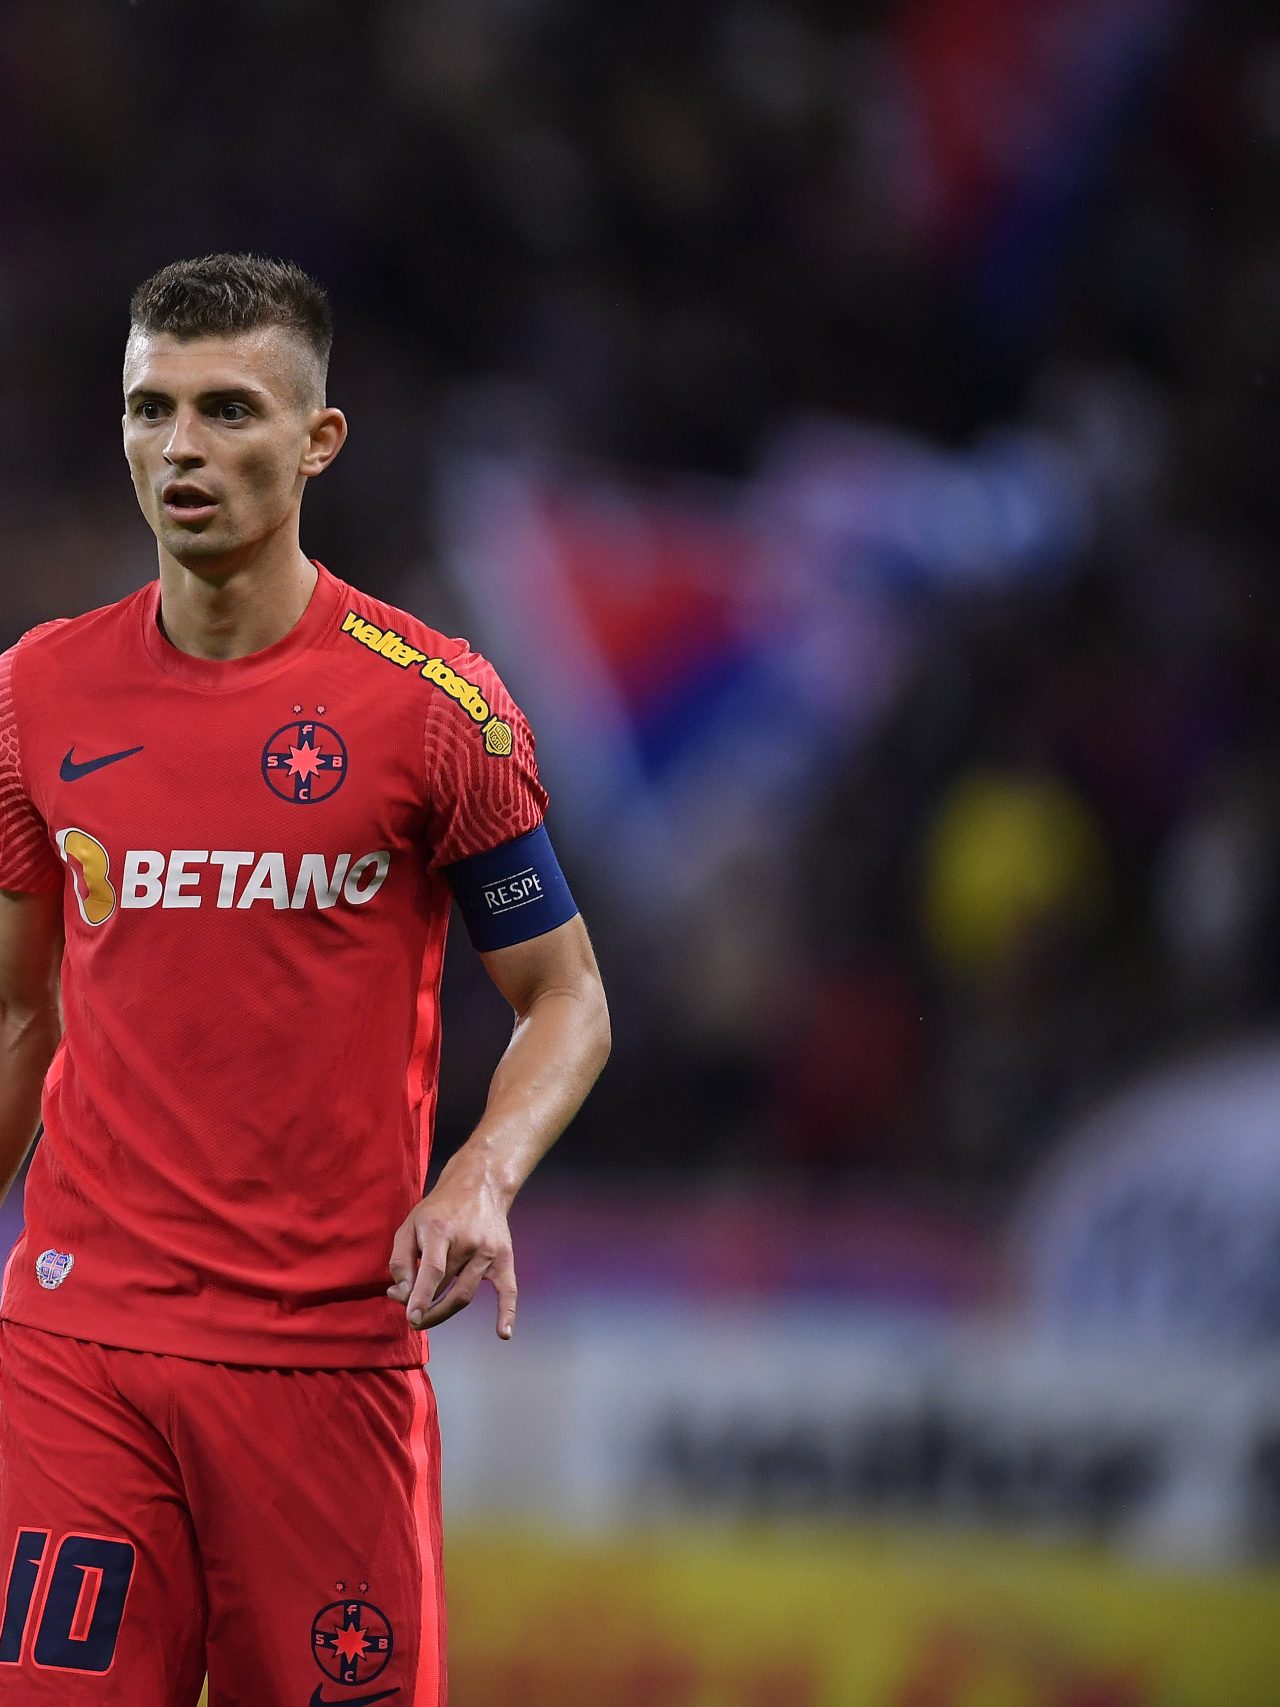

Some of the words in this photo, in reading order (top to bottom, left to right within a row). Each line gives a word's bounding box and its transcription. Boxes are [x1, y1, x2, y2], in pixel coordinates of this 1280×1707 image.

[340, 610, 427, 668] walter
[420, 657, 490, 722] tosto
[267, 755, 279, 767] S
[332, 756, 343, 768] B
[298, 788, 309, 800] C
[120, 850, 391, 910] BETANO
